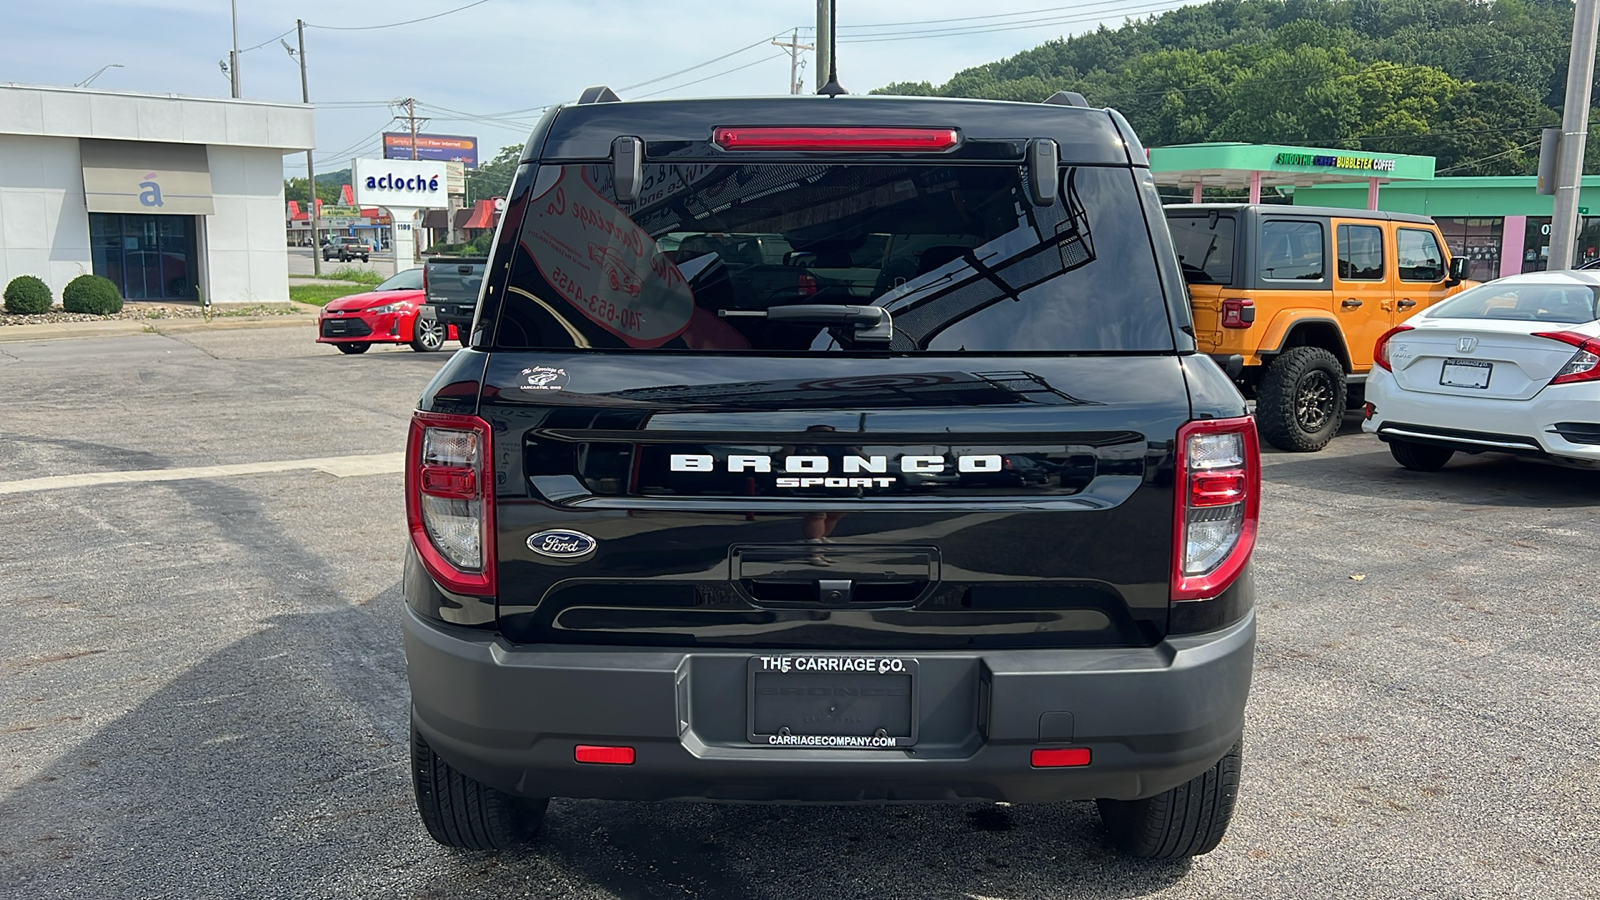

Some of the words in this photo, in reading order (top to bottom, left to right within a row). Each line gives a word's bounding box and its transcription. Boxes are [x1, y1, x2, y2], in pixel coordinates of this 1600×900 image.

[1278, 153, 1314, 166] SMOOTHIE
[1336, 156, 1372, 170] BUBBLETEA
[1373, 158, 1395, 171] COFFEE
[366, 173, 438, 191] acloché
[670, 454, 1002, 473] BRONCO
[776, 477, 896, 488] SPORT
[542, 535, 579, 552] Ford
[760, 656, 792, 670] THE
[795, 658, 876, 672] CARRIAGE
[879, 658, 906, 672] CO.
[768, 736, 896, 747] CARRIAGECOMPANY.COM
